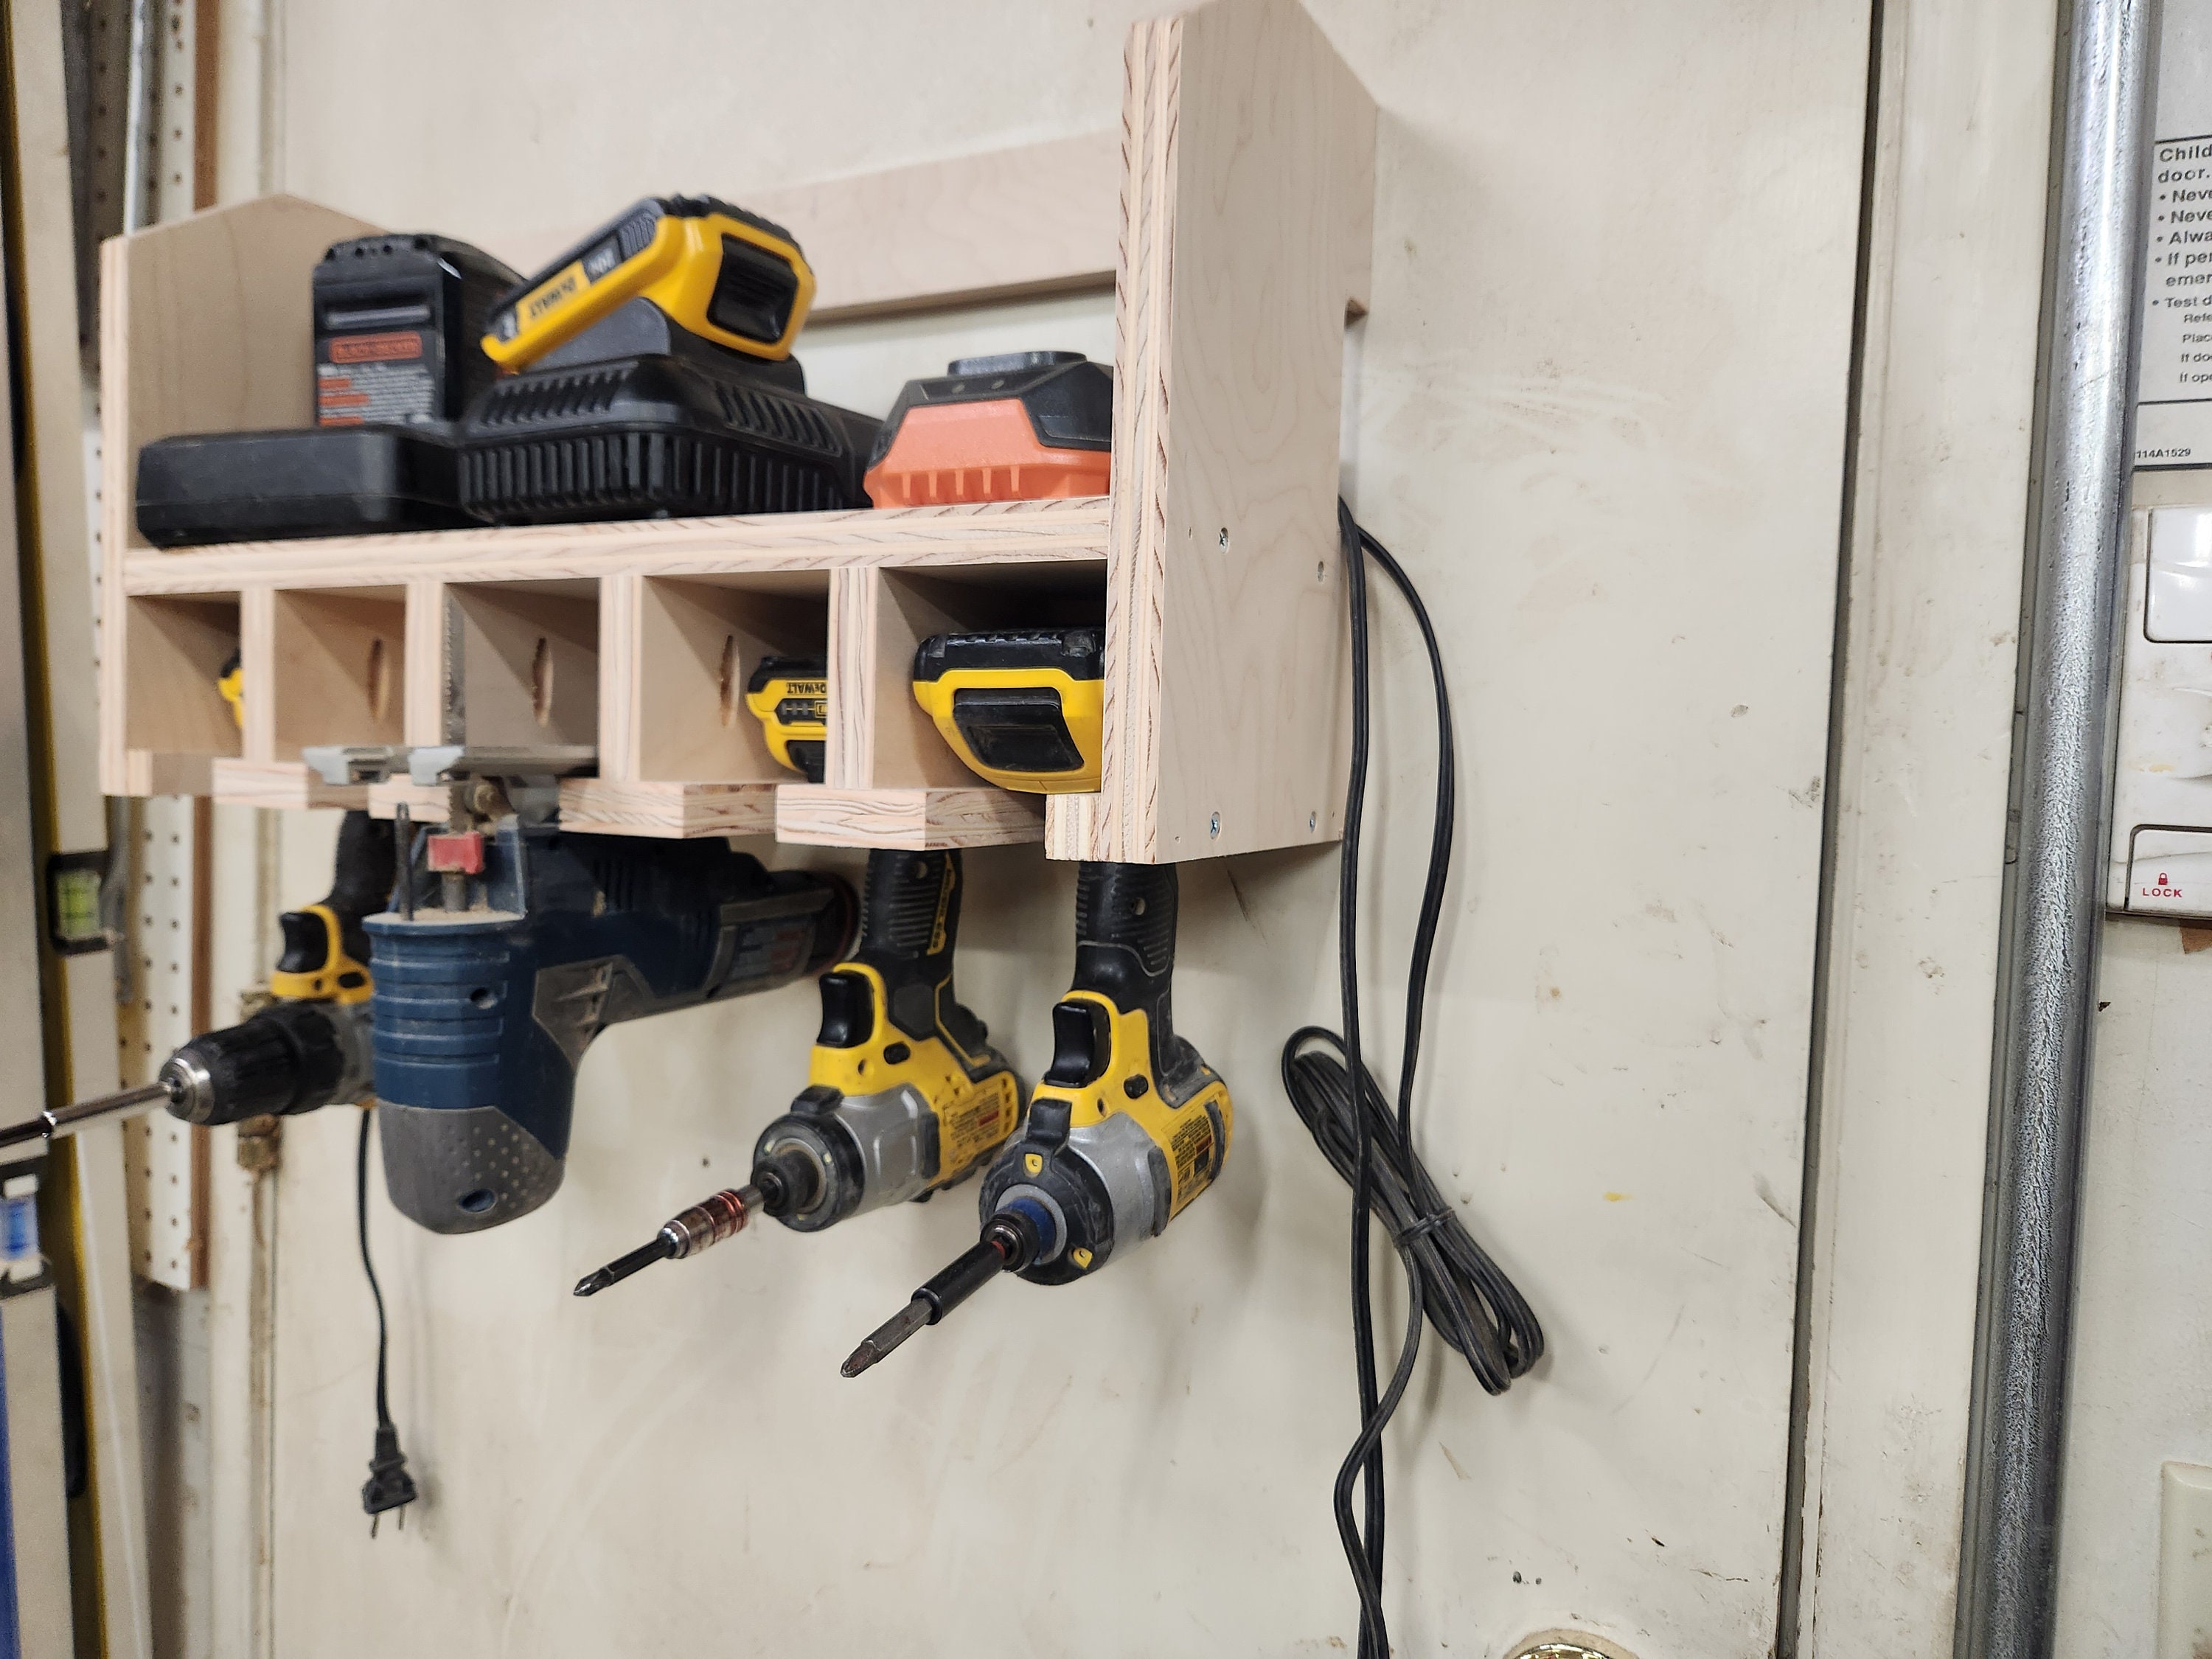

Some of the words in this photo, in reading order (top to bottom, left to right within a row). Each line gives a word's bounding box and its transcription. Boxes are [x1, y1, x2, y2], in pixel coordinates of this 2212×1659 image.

[2160, 145, 2212, 162] Child
[2158, 170, 2210, 183] door.
[2168, 231, 2212, 246] Alwa
[2168, 252, 2179, 265] If
[2165, 296, 2197, 307] Test
[2183, 334, 2212, 343] Plac
[2142, 887, 2183, 898] LOCK
